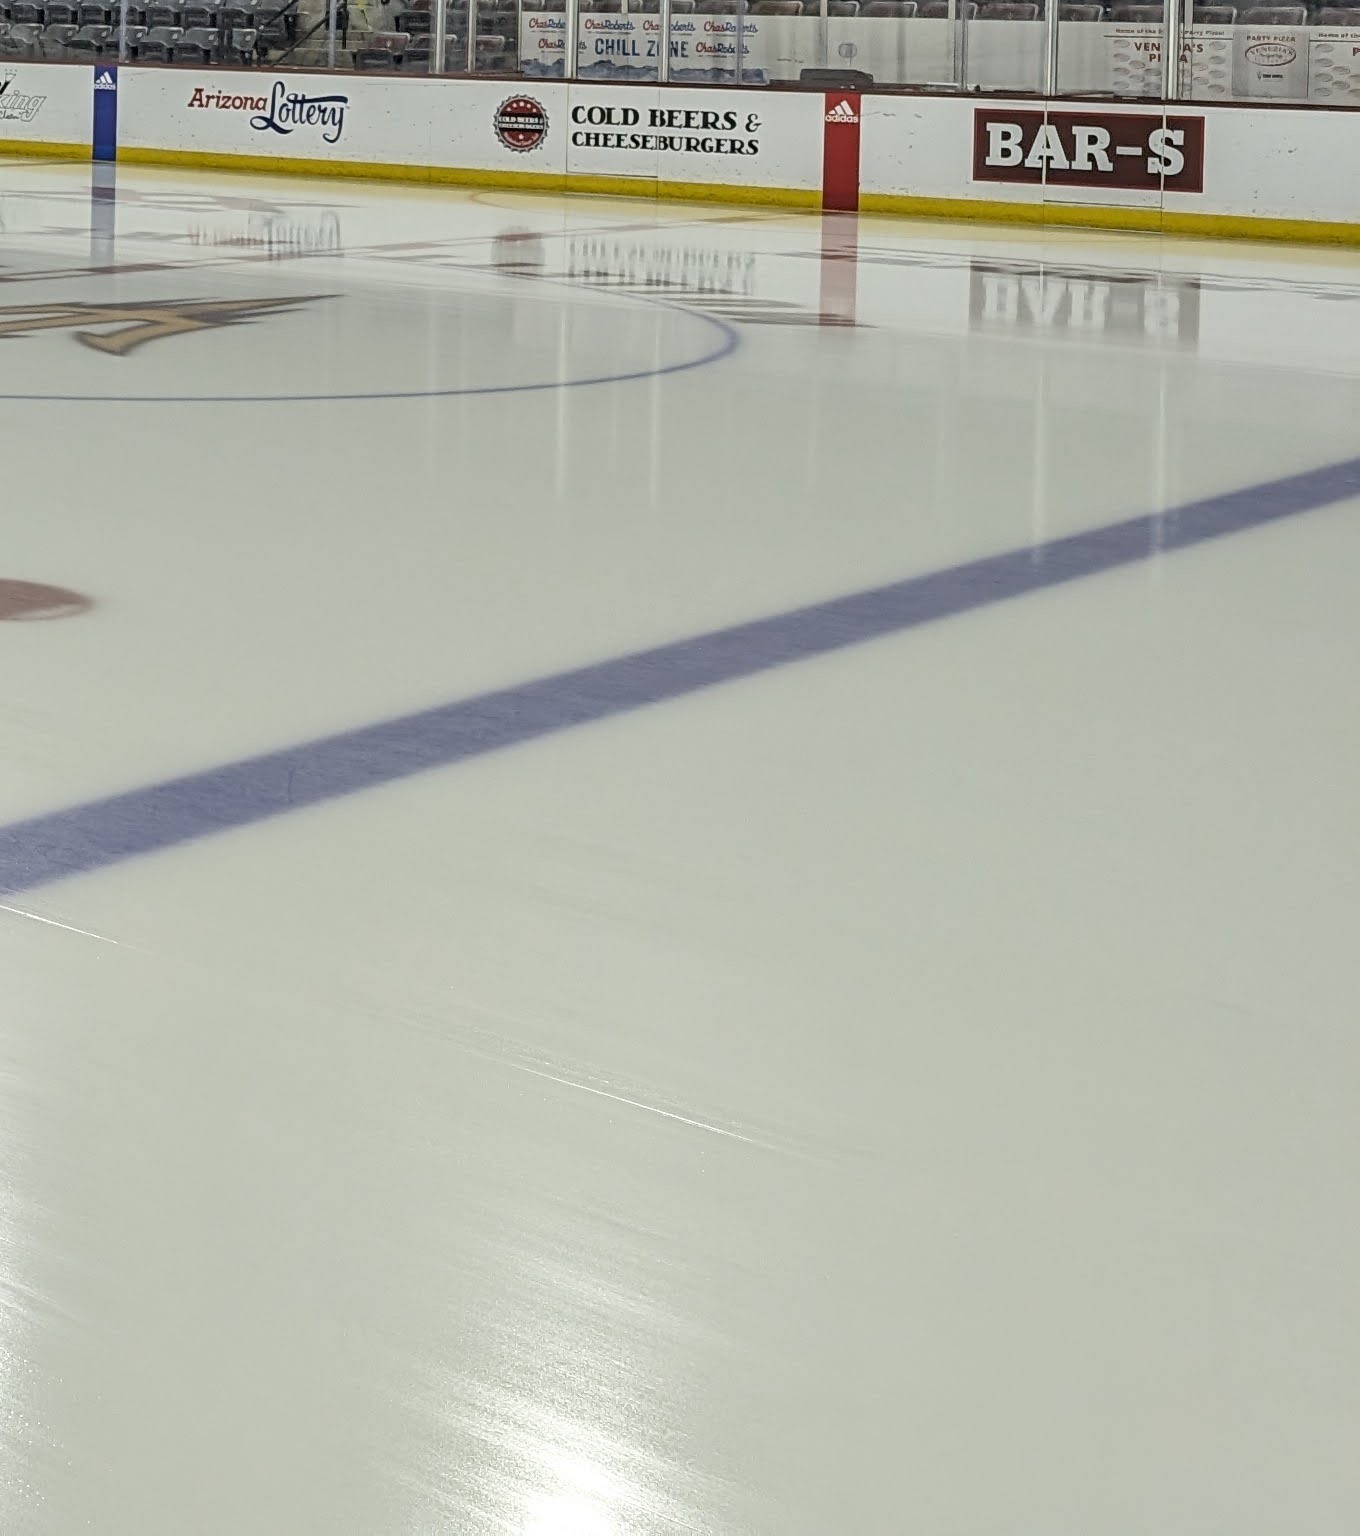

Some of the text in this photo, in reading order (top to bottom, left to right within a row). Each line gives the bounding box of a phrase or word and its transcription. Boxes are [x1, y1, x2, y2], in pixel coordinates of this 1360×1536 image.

[642, 19, 696, 32] Chaoberts
[595, 38, 689, 57] CHILL ZNE
[1134, 42, 1204, 53] VENA'S
[1149, 53, 1188, 64] PIA
[188, 80, 349, 143] Arizona Lottery
[571, 105, 763, 133] COLD BEERS &
[825, 113, 859, 124] adidas
[571, 131, 760, 156] CHEESEBURGERS
[984, 121, 1184, 176] BAR-S
